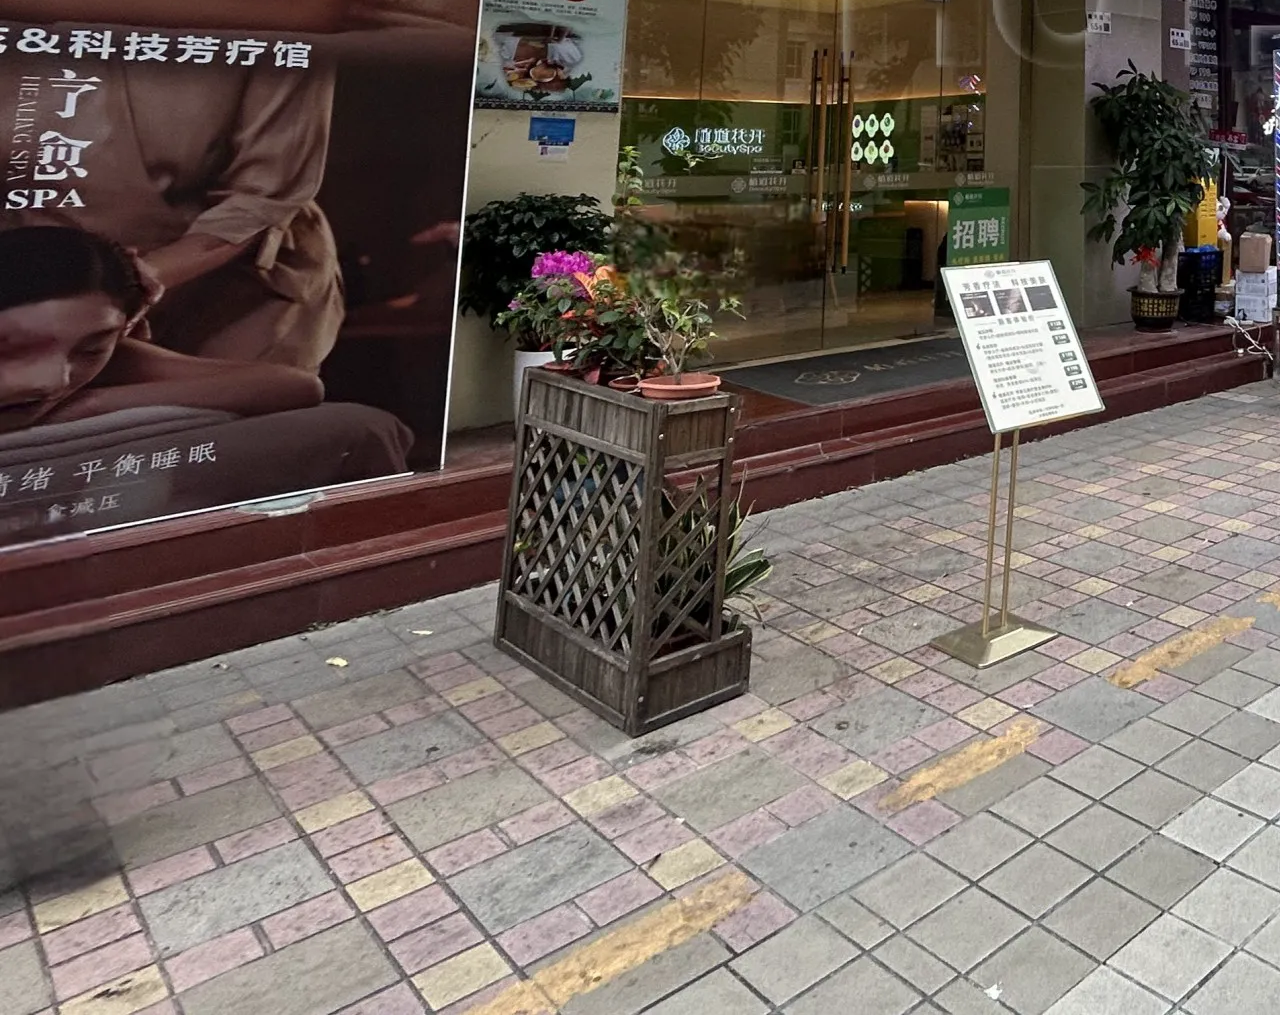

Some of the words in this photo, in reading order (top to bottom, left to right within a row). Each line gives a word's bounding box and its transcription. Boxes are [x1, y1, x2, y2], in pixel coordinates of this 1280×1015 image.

[5, 187, 86, 210] SPA
[952, 217, 1000, 250] 招聘
[73, 441, 217, 483] 平衡睡眠
